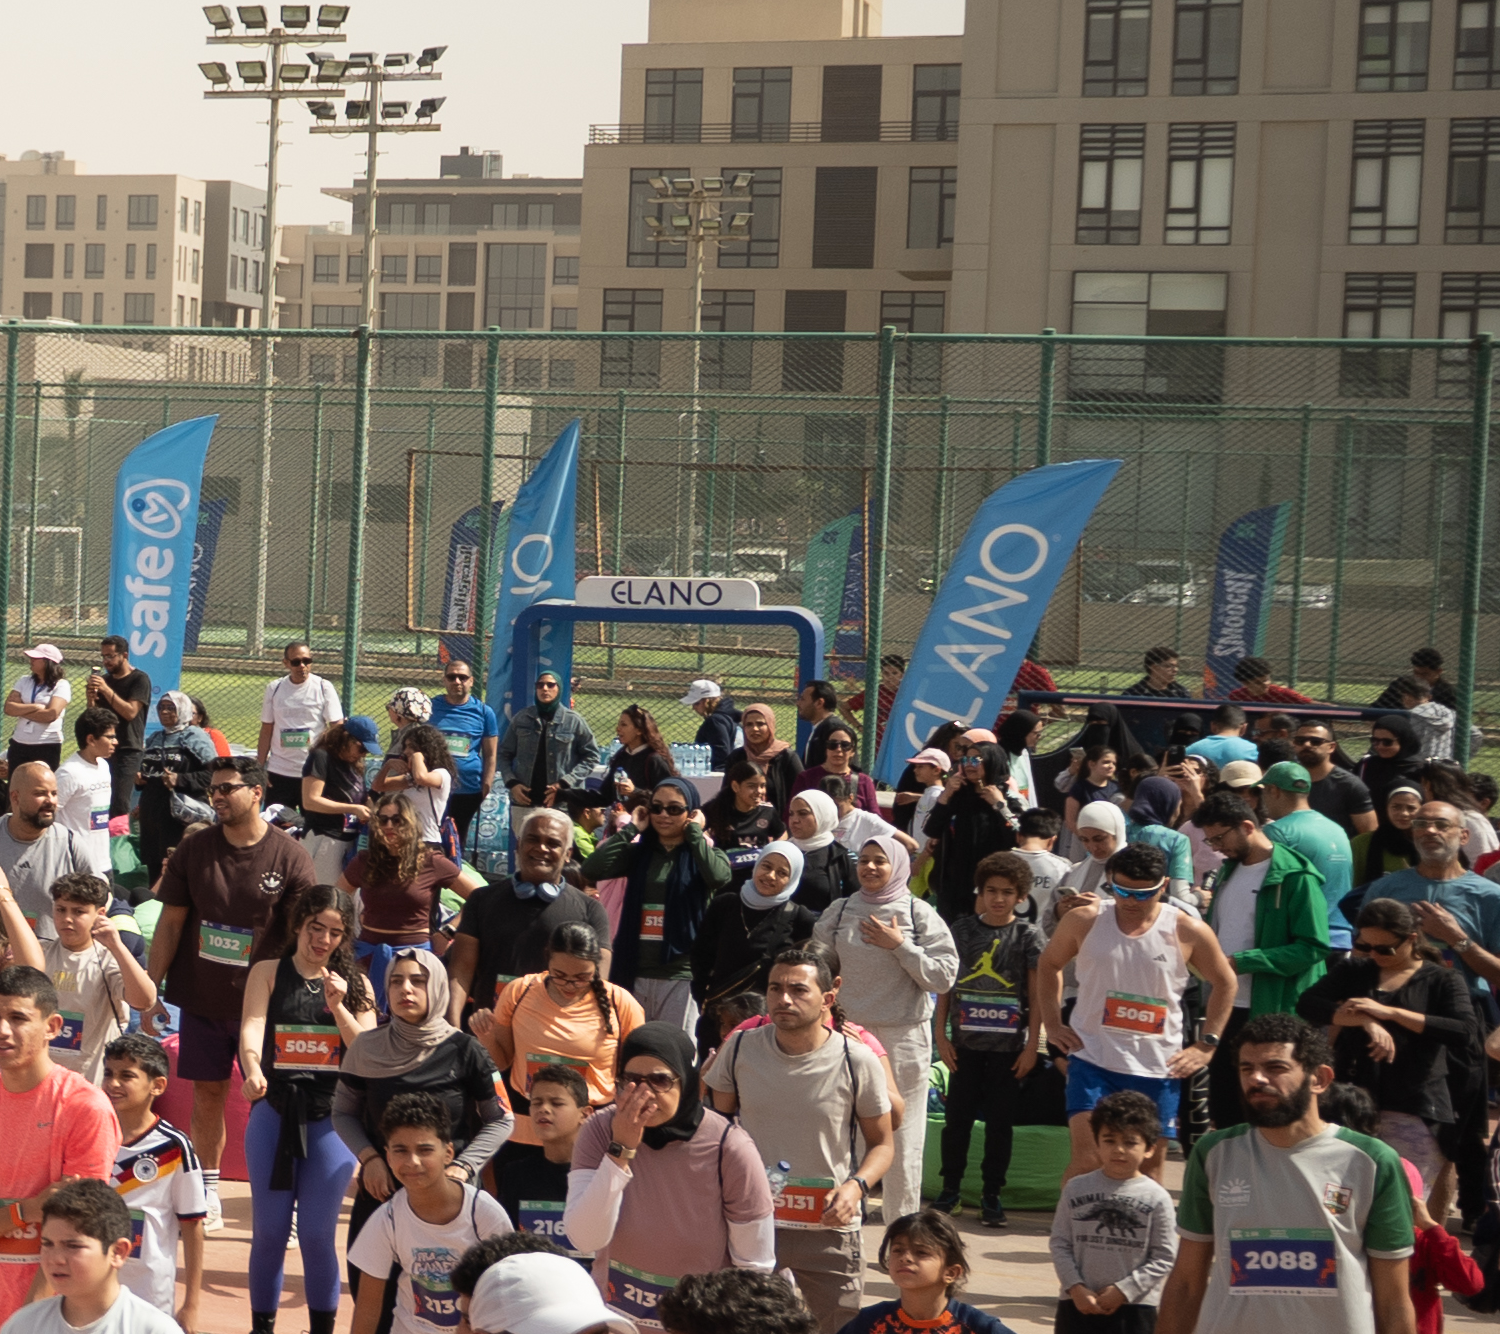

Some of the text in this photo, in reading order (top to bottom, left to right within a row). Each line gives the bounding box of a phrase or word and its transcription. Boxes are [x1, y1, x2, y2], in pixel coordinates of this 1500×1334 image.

[127, 546, 174, 658] safe
[209, 934, 241, 951] 1032
[970, 1007, 1009, 1020] 2006
[1116, 1006, 1157, 1024] 5061
[285, 1039, 330, 1055] 5054
[1244, 1251, 1318, 1271] 2088
